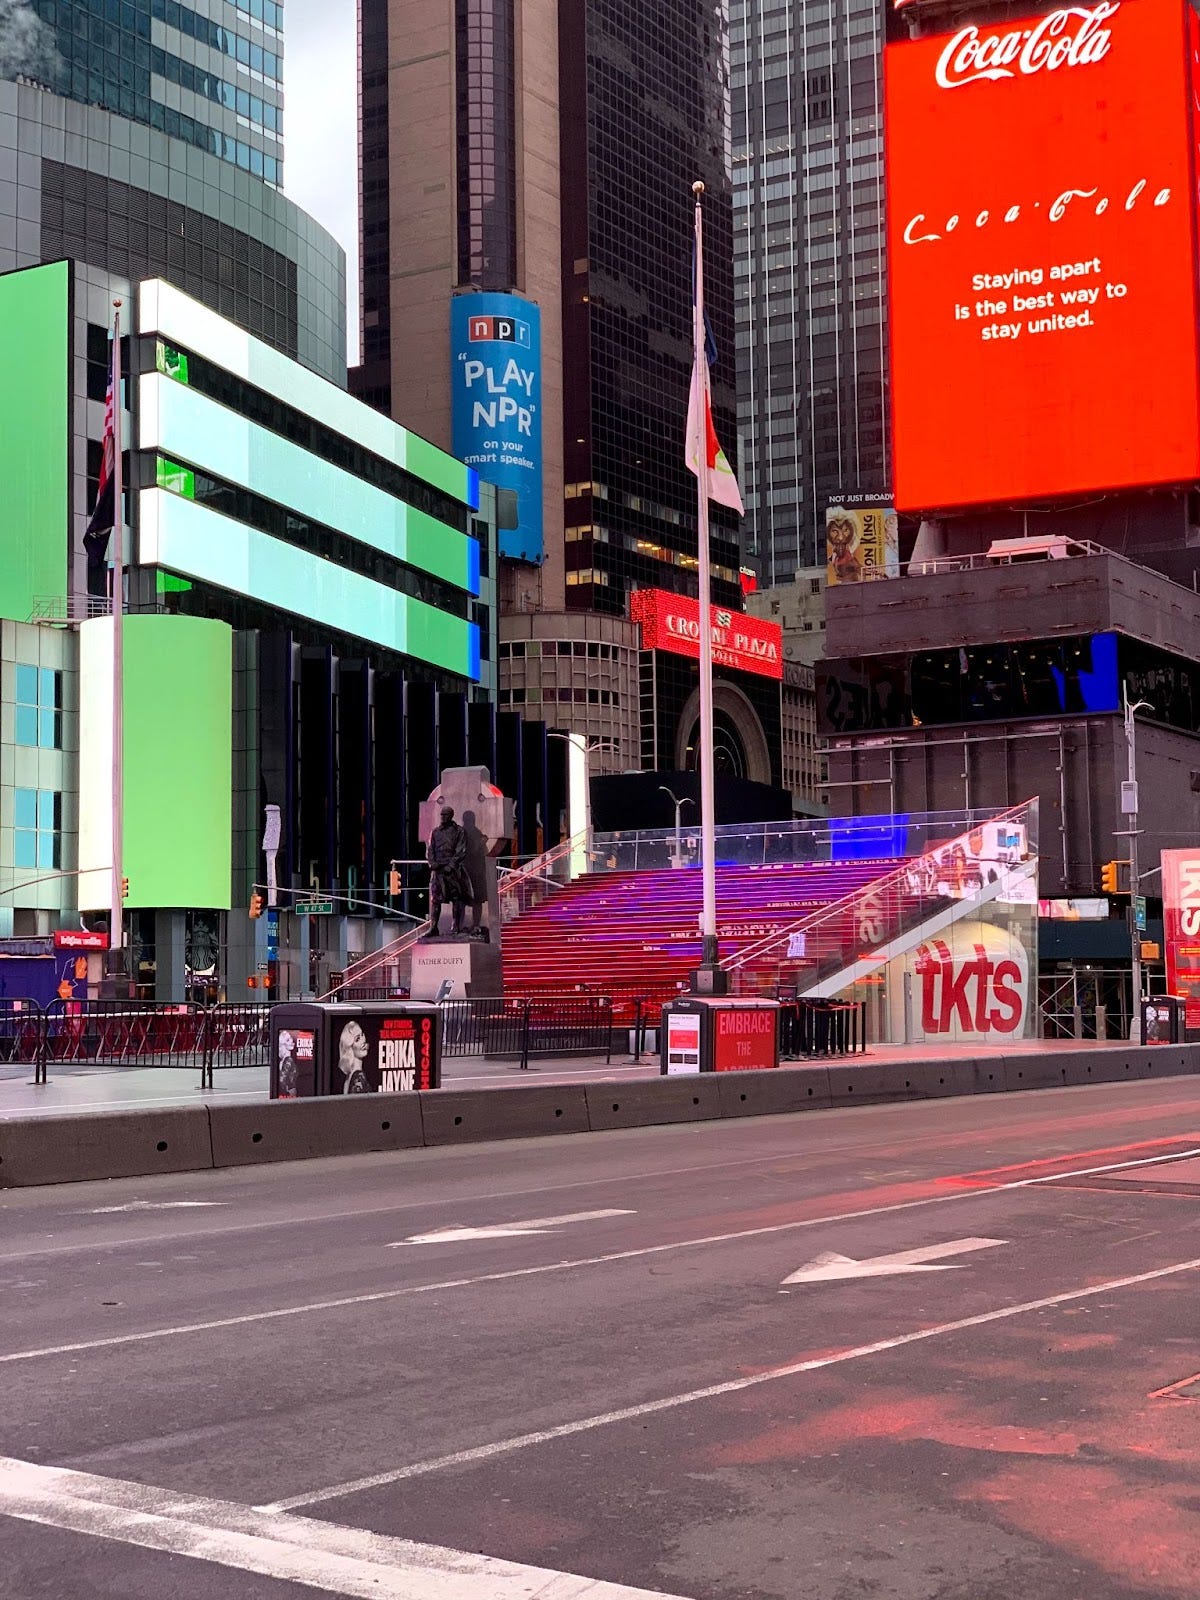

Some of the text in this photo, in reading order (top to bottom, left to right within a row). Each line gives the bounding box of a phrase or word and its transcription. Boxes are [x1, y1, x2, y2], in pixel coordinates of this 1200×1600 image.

[972, 257, 1101, 291] Staying apart
[955, 282, 1128, 320] is the best way to
[474, 320, 526, 341] npr
[981, 310, 1094, 341] stay united.
[483, 440, 523, 452] on your
[464, 453, 535, 470] smart speaker.
[829, 494, 845, 503] NOT
[847, 494, 864, 502] JUST
[860, 515, 877, 545] KING
[735, 632, 777, 659] PLAZA
[418, 957, 465, 966] FATHER DUFFY
[914, 939, 1022, 1034] tkts
[719, 1012, 771, 1035] EMBRACE
[296, 1038, 313, 1048] ERIKA
[296, 1047, 313, 1057] JAYNE
[378, 1040, 416, 1069] ERIKA
[421, 1018, 431, 1091] HICAGO
[736, 1041, 752, 1056] THE
